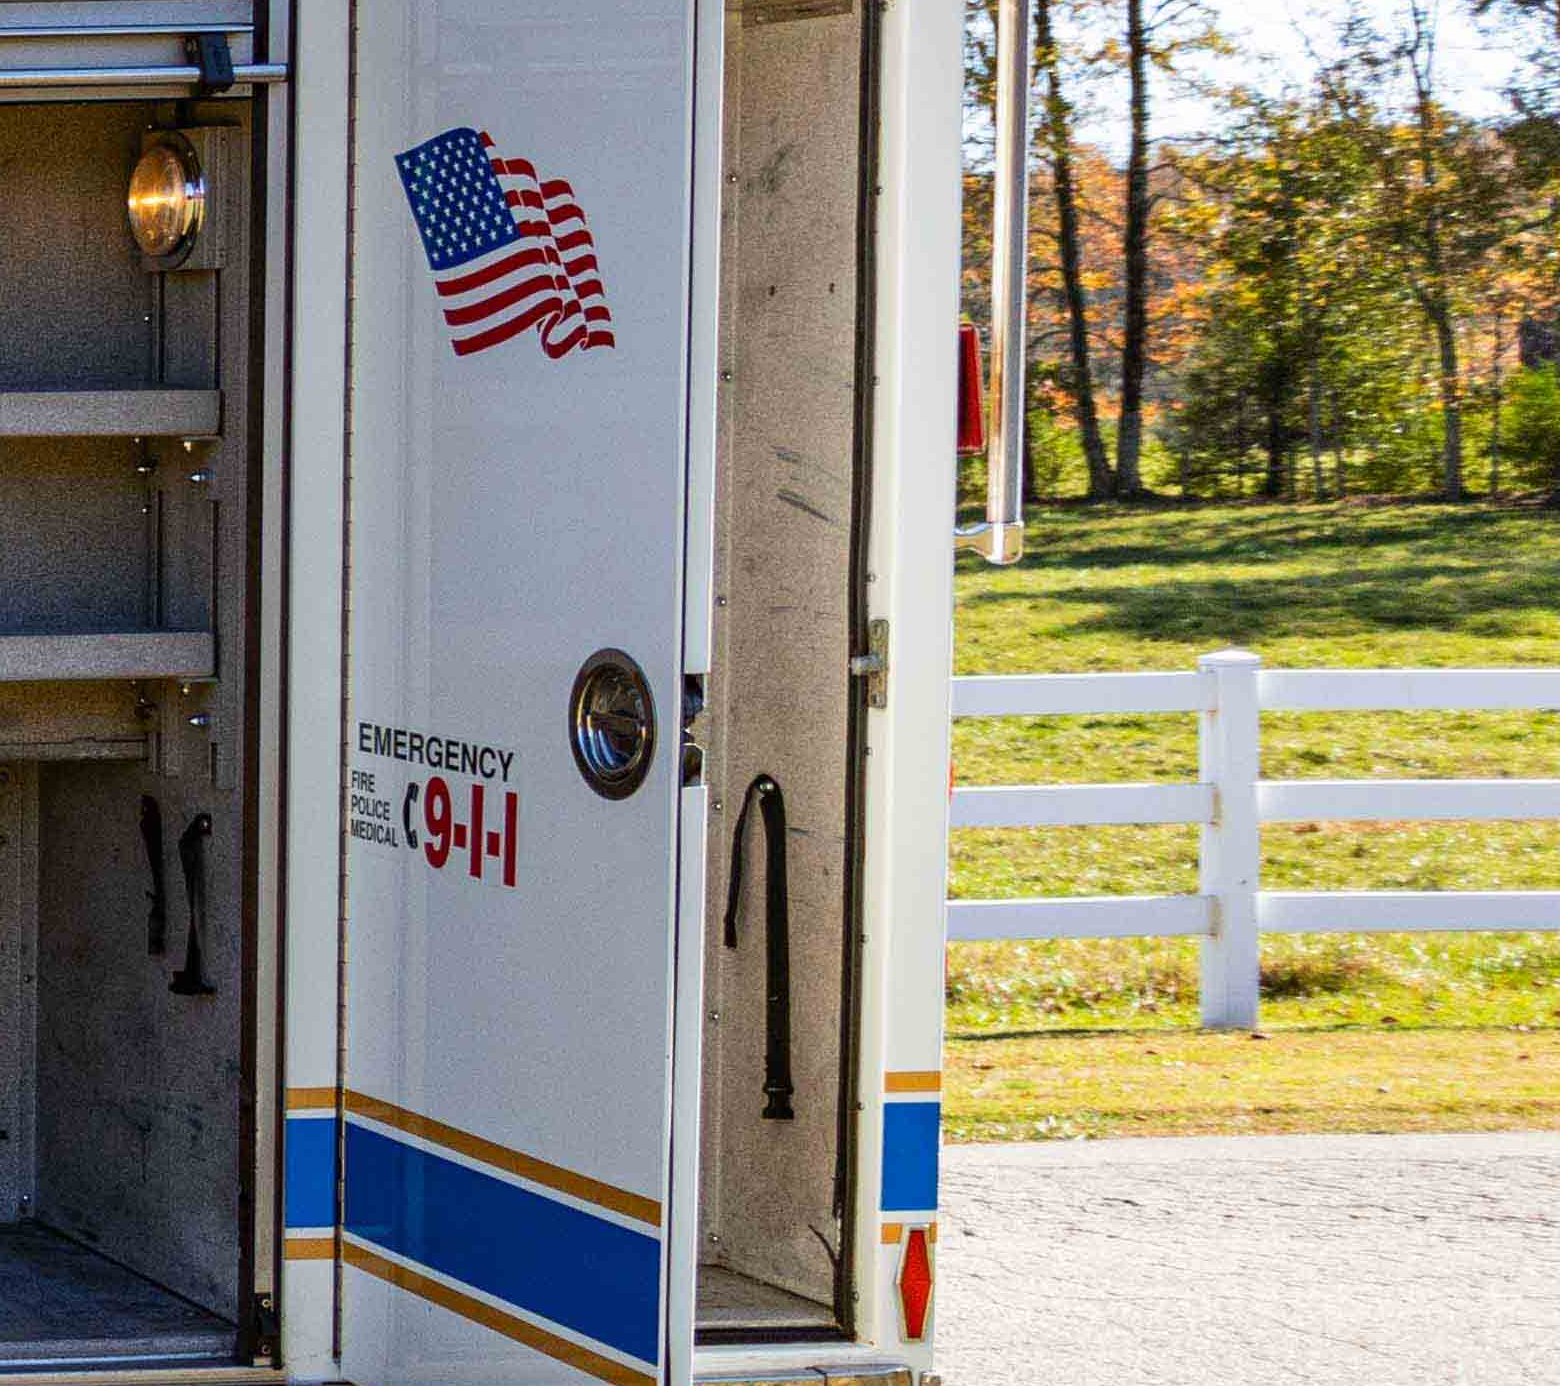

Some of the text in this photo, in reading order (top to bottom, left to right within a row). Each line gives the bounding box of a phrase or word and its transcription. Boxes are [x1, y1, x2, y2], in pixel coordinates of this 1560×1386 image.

[358, 721, 514, 783] EMERGENCY
[351, 770, 376, 794] FIRE
[350, 794, 391, 822] POLICE
[350, 818, 399, 848] MEDICAL
[423, 775, 518, 888] 9-1-1
